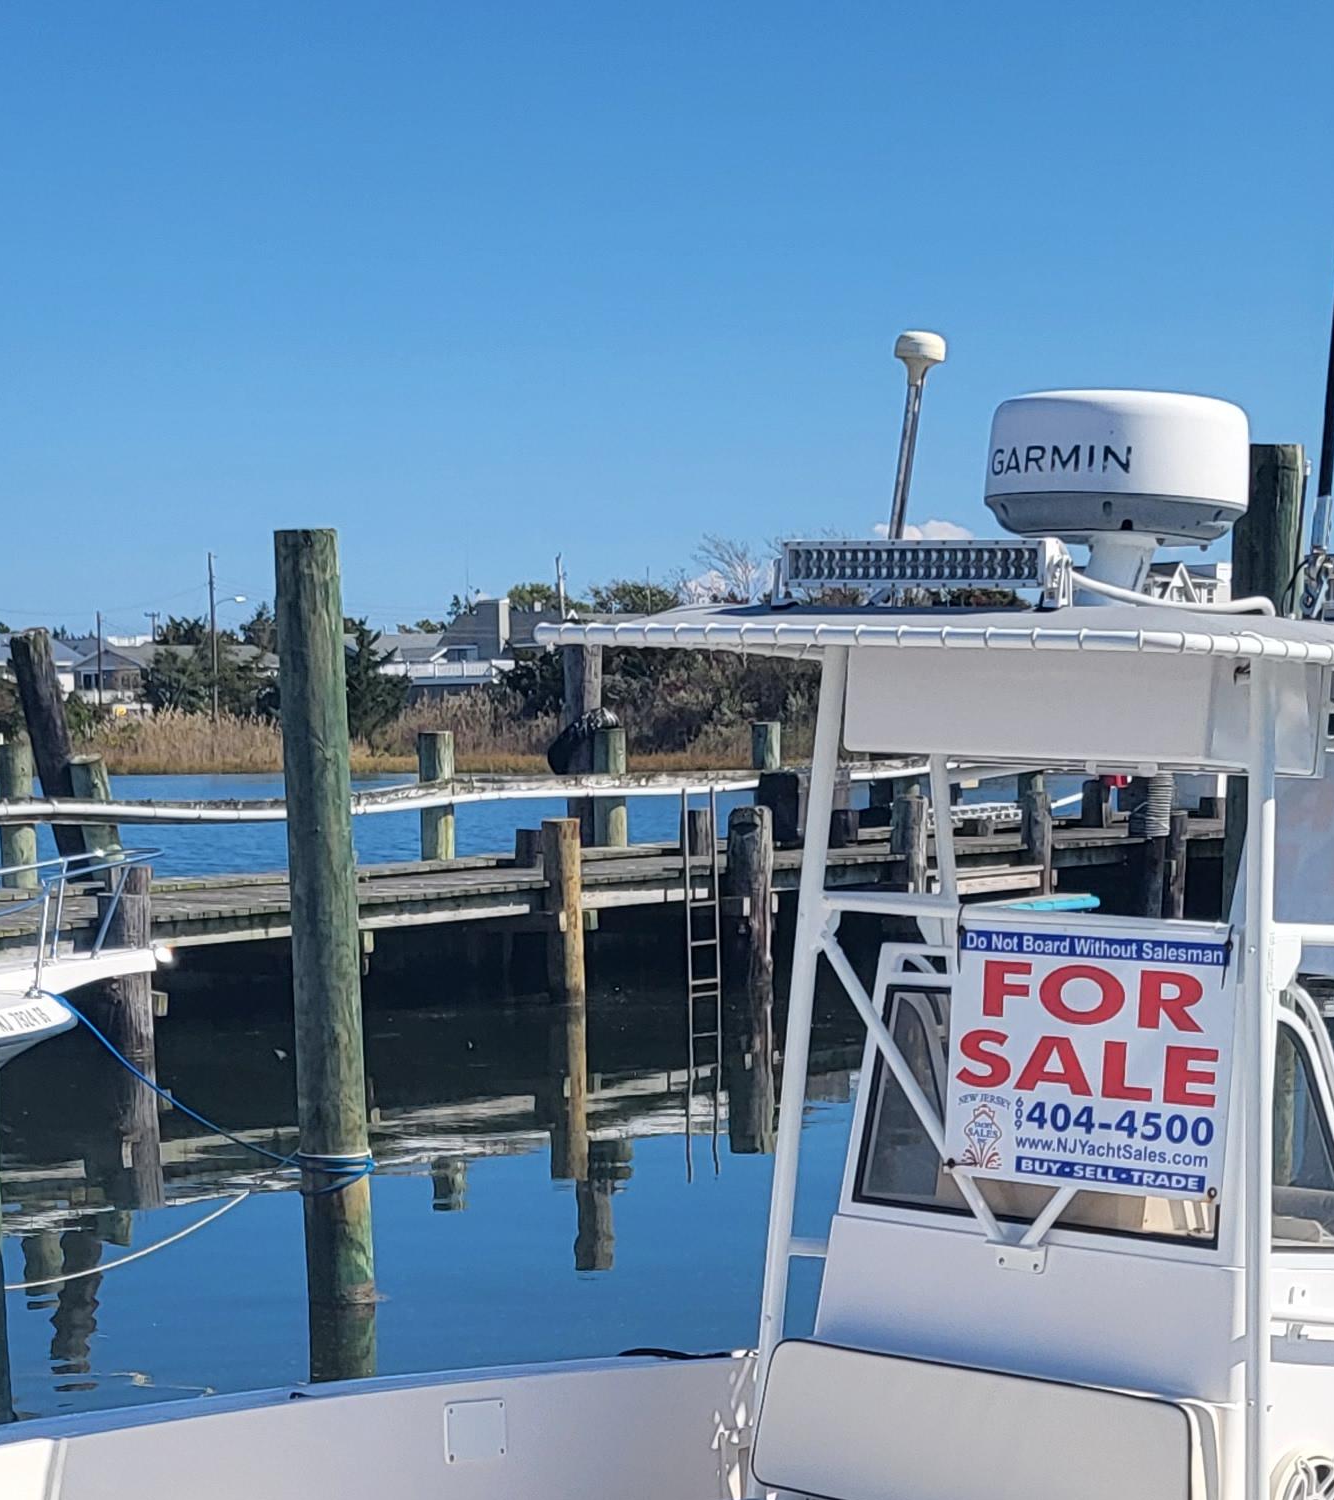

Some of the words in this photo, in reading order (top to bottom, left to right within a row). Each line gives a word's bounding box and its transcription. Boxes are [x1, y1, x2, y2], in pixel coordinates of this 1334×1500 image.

[991, 444, 1132, 476] GARMIN
[966, 932, 987, 951] Do
[991, 933, 1018, 952] Not
[1022, 935, 1068, 954] Board
[1075, 938, 1137, 959] Without
[1142, 943, 1224, 964] Salesman
[982, 959, 1205, 1034] FOR
[955, 1028, 1219, 1108] SALE
[979, 1093, 1011, 1110] JERSEY
[968, 1127, 998, 1138] SALES
[1025, 1101, 1215, 1147] 404-4500
[1015, 1135, 1209, 1168] www.NJYachtSales.com
[1020, 1159, 1063, 1173] BUY
[1073, 1165, 1118, 1182] SELL
[1130, 1171, 1200, 1190] TRADE
